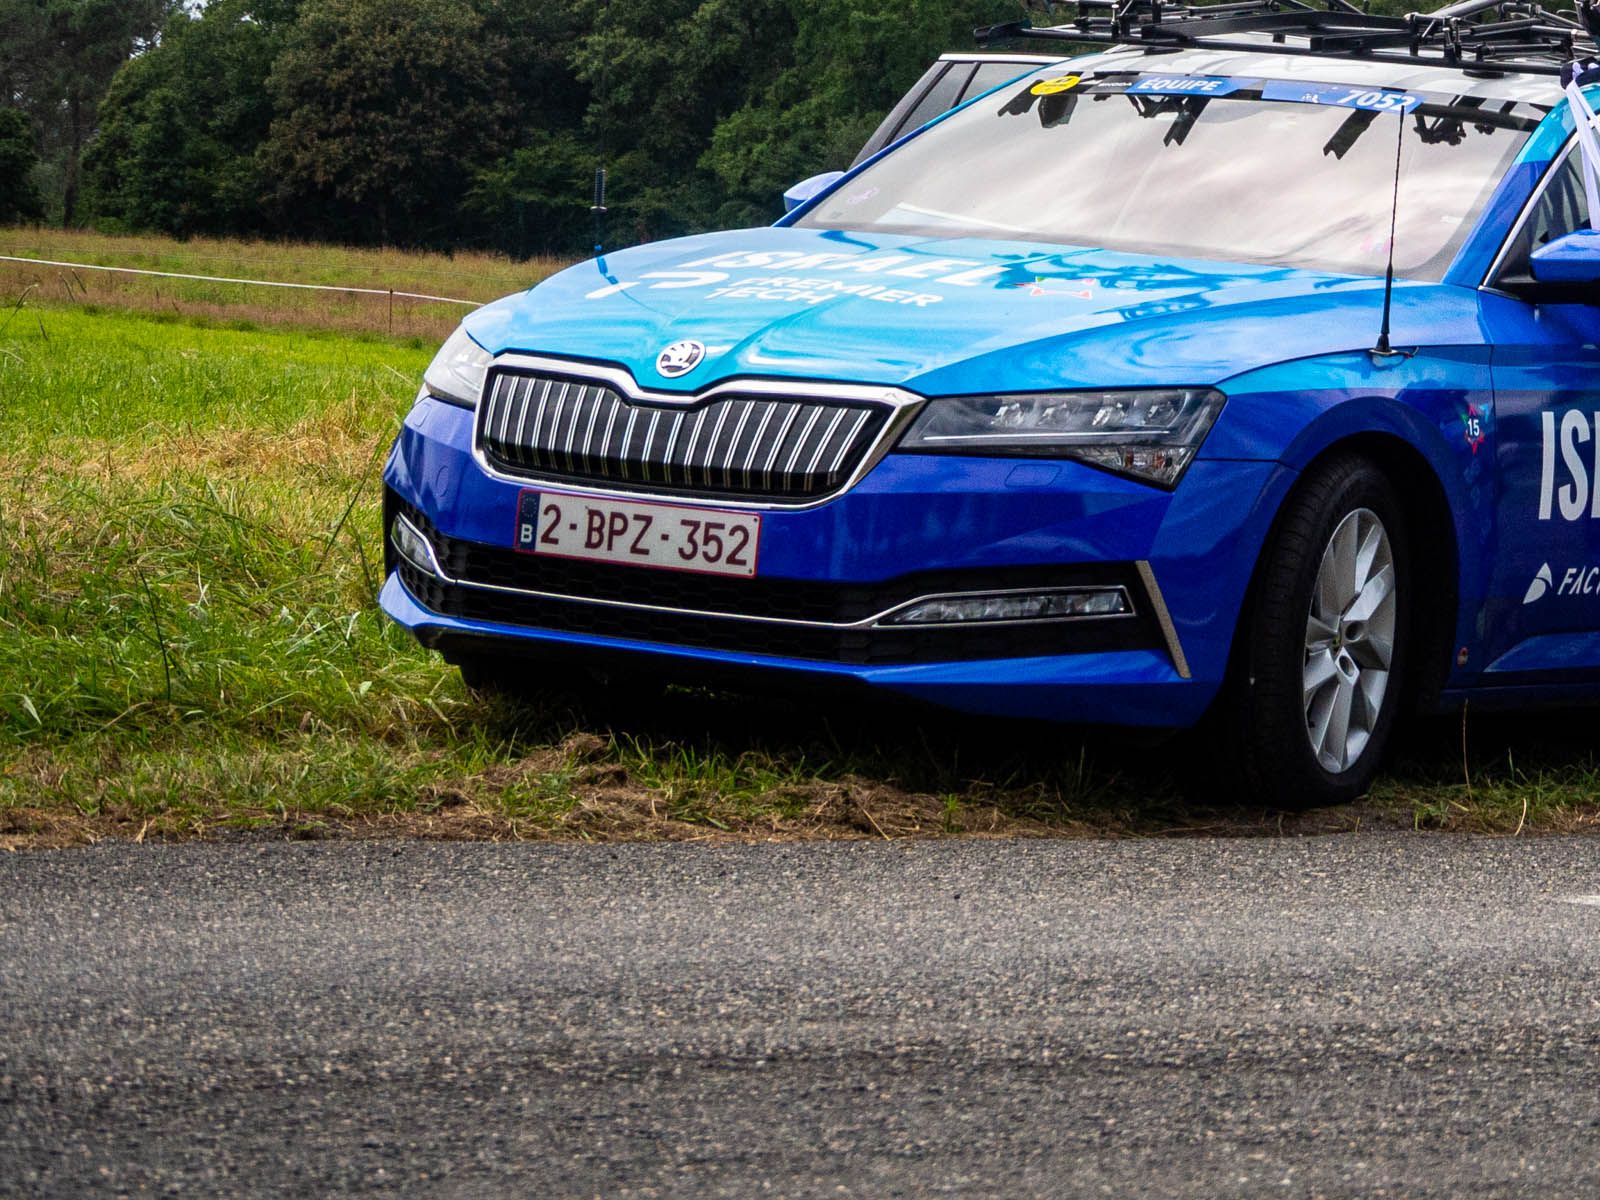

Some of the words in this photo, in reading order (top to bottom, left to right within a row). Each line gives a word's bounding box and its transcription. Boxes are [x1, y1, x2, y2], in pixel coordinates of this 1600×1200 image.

[1337, 89, 1417, 111] 7052
[676, 251, 1012, 287] ISRAEL
[704, 287, 837, 305] TECH
[728, 277, 944, 307] PREMIER
[1467, 418, 1480, 437] 15
[520, 524, 533, 543] B
[540, 503, 750, 567] 2-BPZ-352
